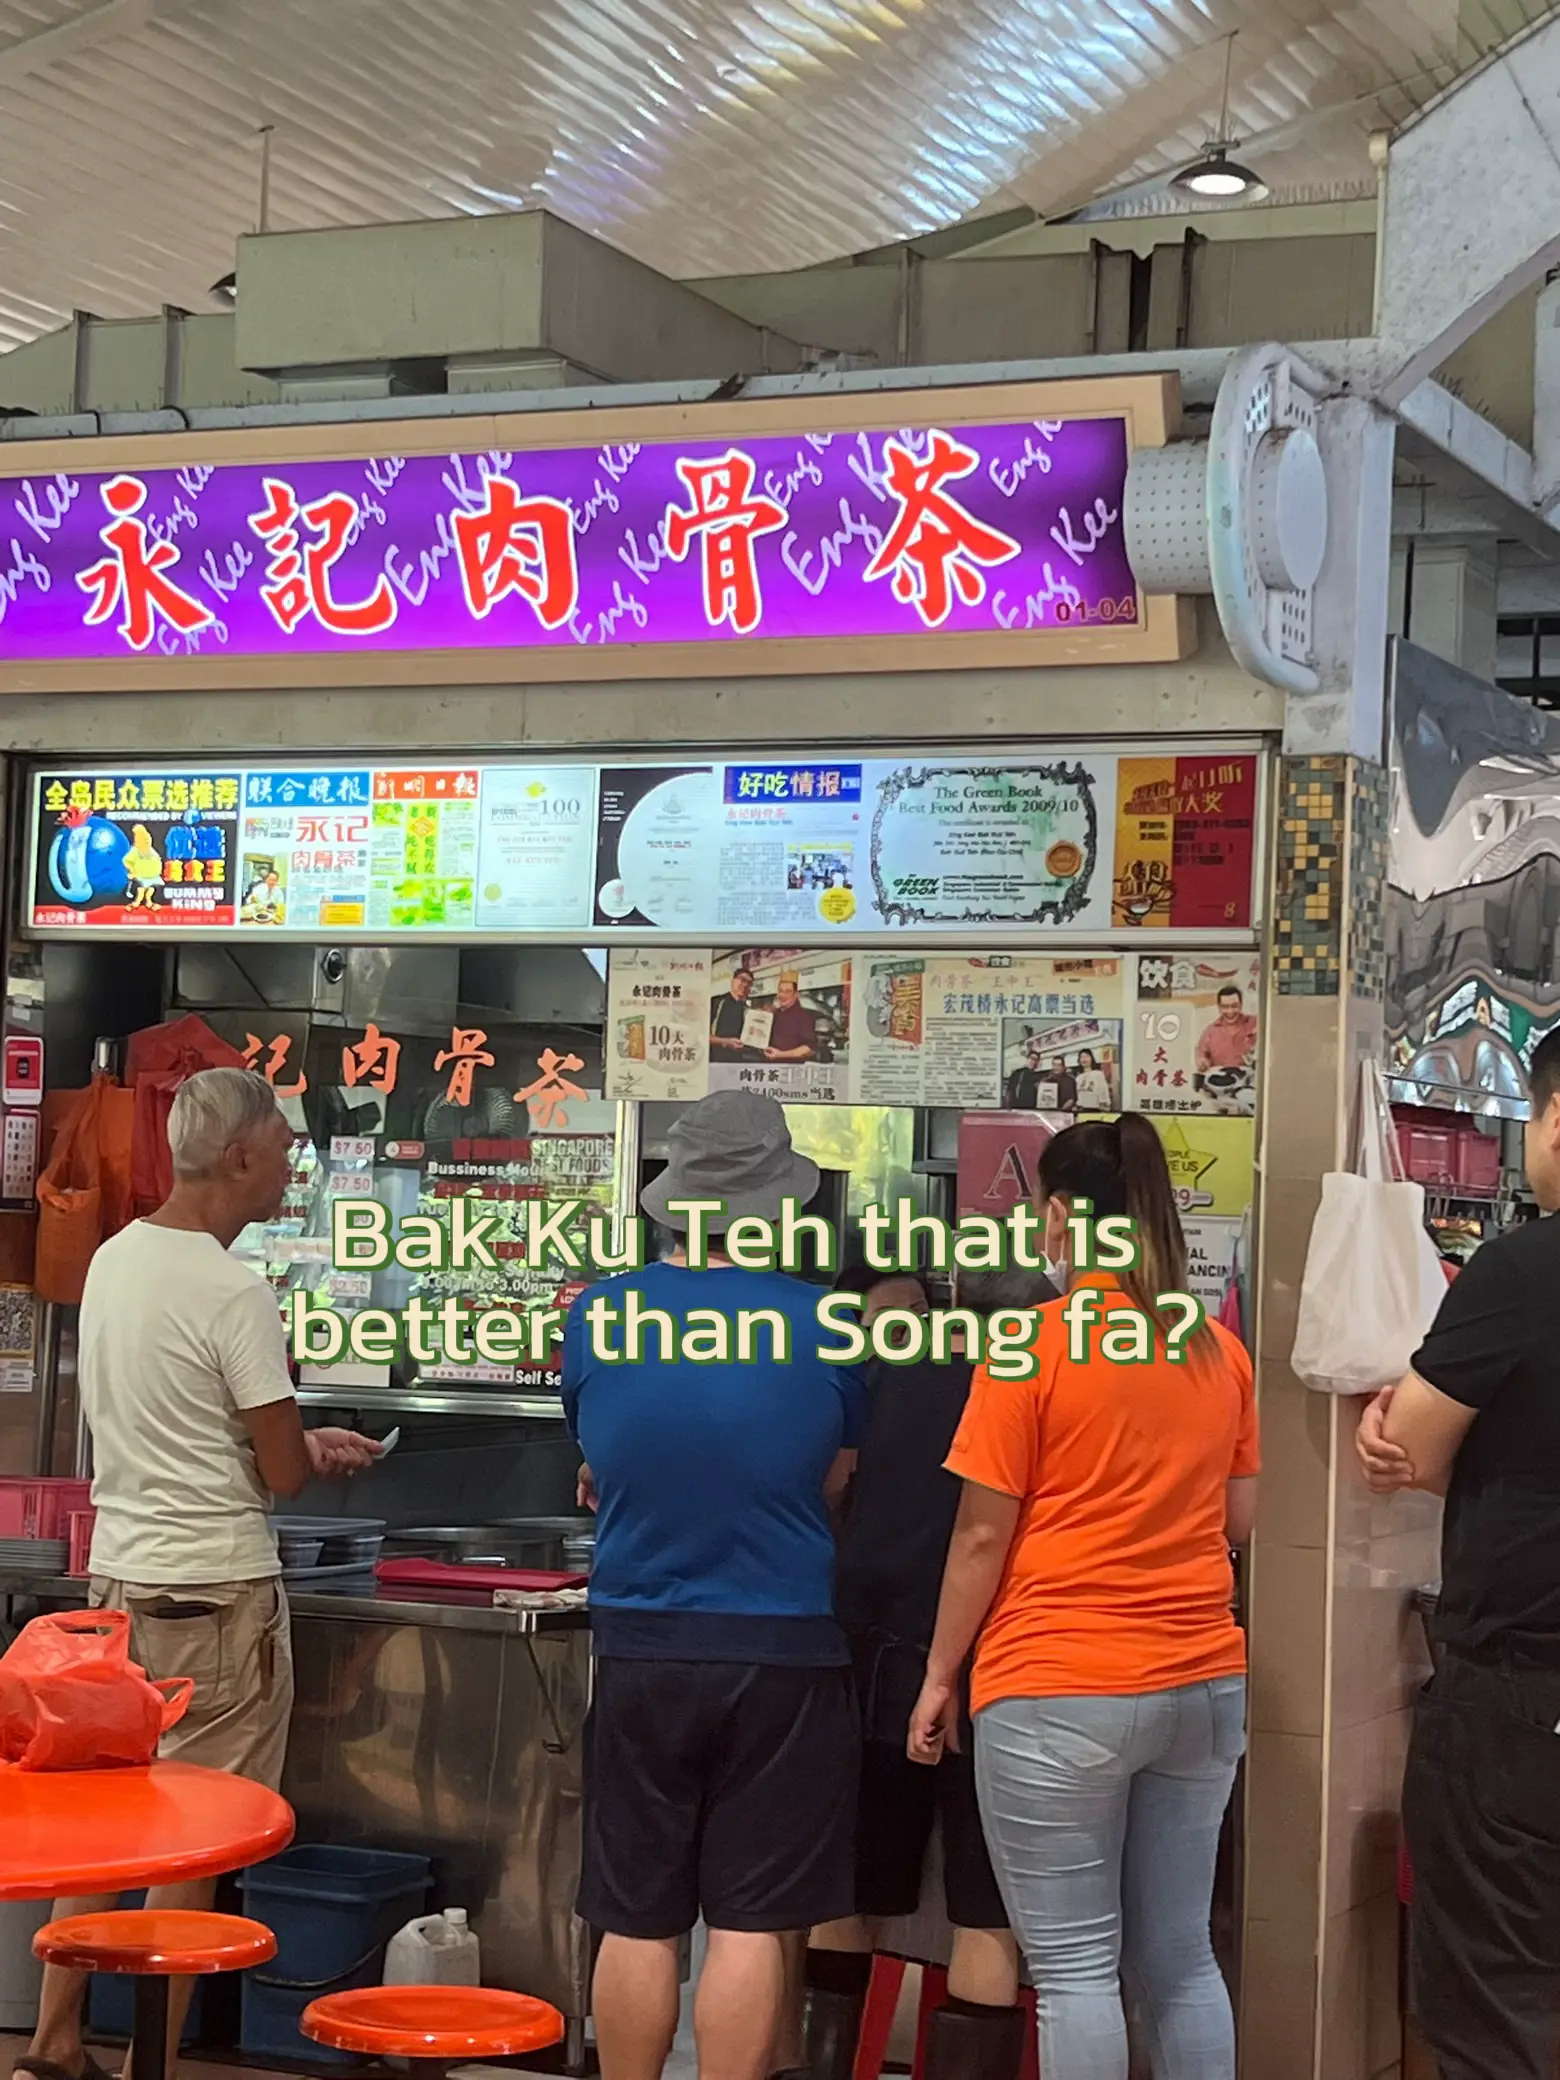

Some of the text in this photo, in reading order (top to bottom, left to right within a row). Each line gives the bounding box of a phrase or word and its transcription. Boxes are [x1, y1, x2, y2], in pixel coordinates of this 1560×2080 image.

[764, 451, 823, 508] Eng
[989, 437, 1052, 497] Eng
[75, 428, 1022, 651] 永記肉骨茶
[1049, 497, 1118, 567] Kee
[781, 497, 884, 596] Eng
[0, 538, 51, 624] ng
[199, 540, 253, 603] Kee
[1055, 596, 1135, 623] 01-04
[44, 778, 238, 811] 全岛民众票选推荐
[737, 771, 841, 797] 好吃情报
[935, 785, 1043, 799] The Green Book
[900, 799, 1079, 816] Best Food Awards 2009/10
[296, 816, 369, 842] 永记
[893, 878, 939, 887] GREEN
[897, 887, 939, 896] BOOK
[1139, 959, 1197, 990] 饮食
[632, 985, 682, 999] 永记肉骨茶
[943, 992, 1095, 1016] 宏茂桥永记高票当选
[1140, 1011, 1181, 1041] 10
[659, 1047, 696, 1062] 肉骨茶
[1154, 1046, 1168, 1064] 大
[1136, 1069, 1188, 1088] 肉骨茶
[531, 1138, 613, 1157] SINGAPORE
[428, 1161, 505, 1177] Bussiness
[1182, 1161, 1199, 1172] US
[515, 1369, 541, 1386] Self
